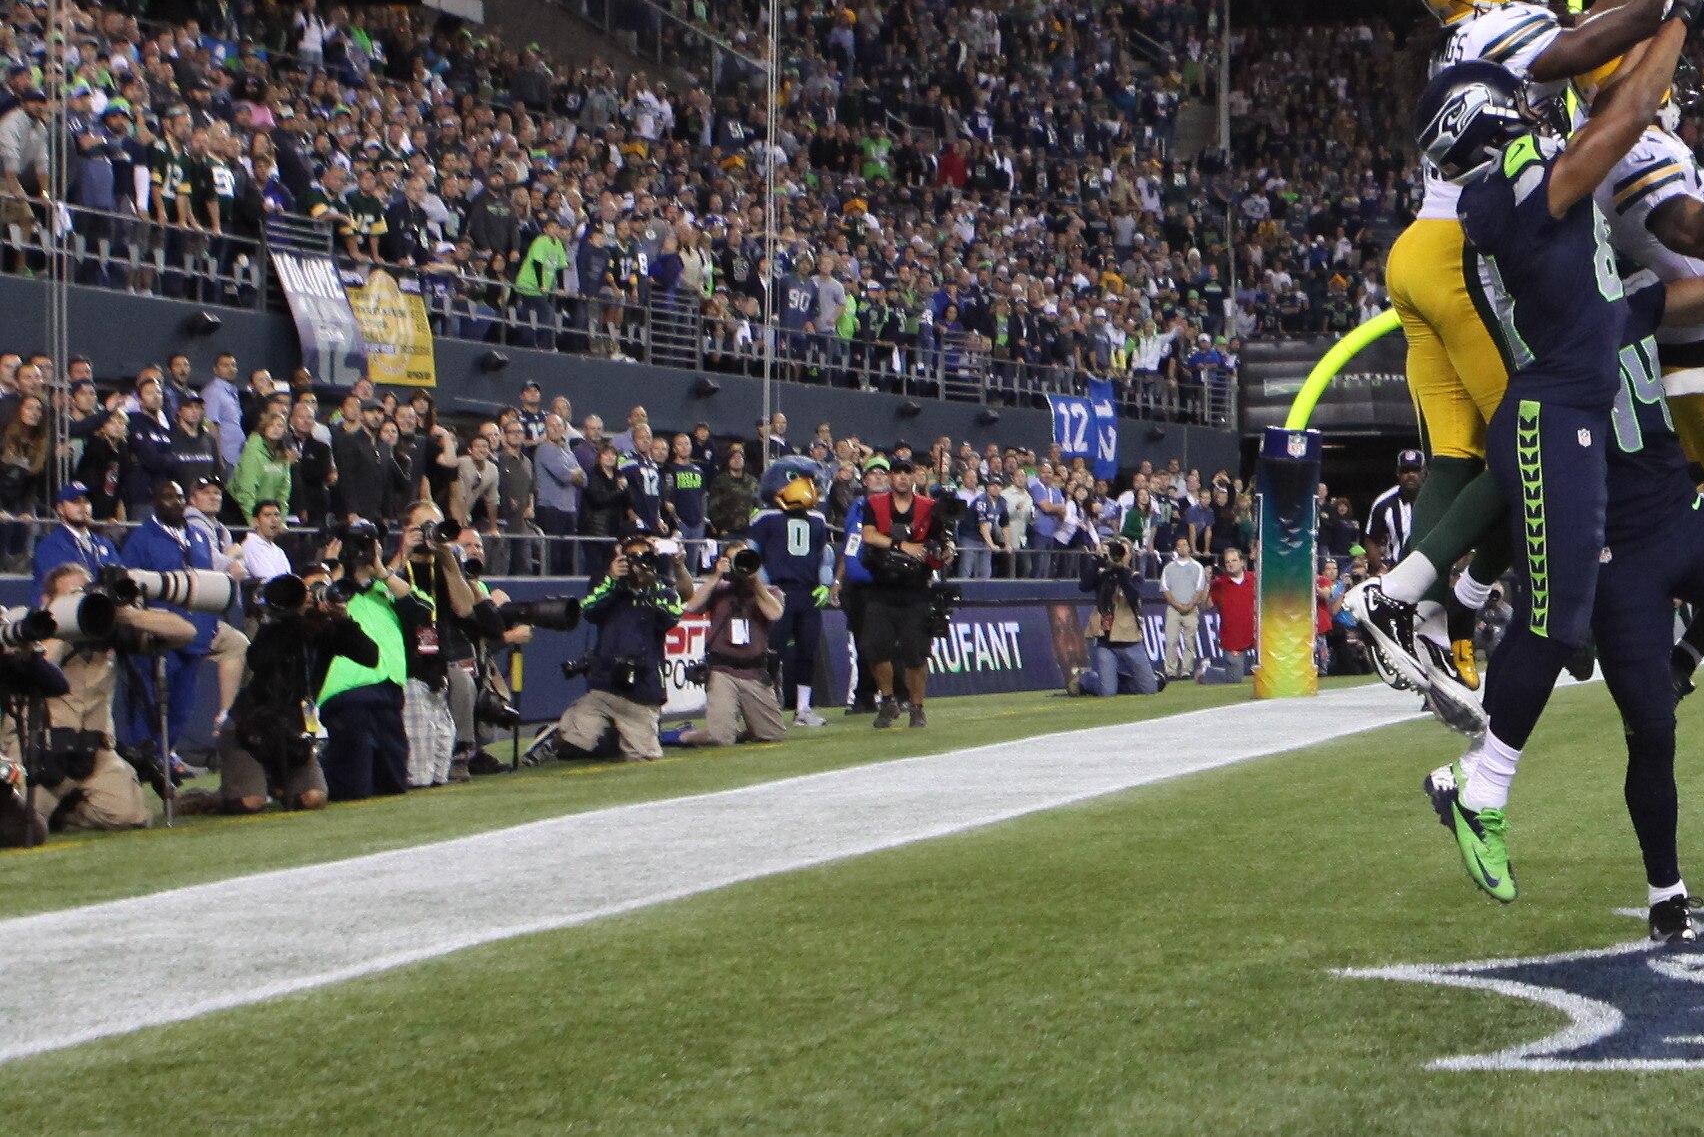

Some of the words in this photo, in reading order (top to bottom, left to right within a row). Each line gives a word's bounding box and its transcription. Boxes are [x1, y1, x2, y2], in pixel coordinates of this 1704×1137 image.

[1058, 402, 1090, 453] 12
[1093, 399, 1118, 463] 12
[639, 466, 661, 497] 12
[786, 518, 812, 557] 0
